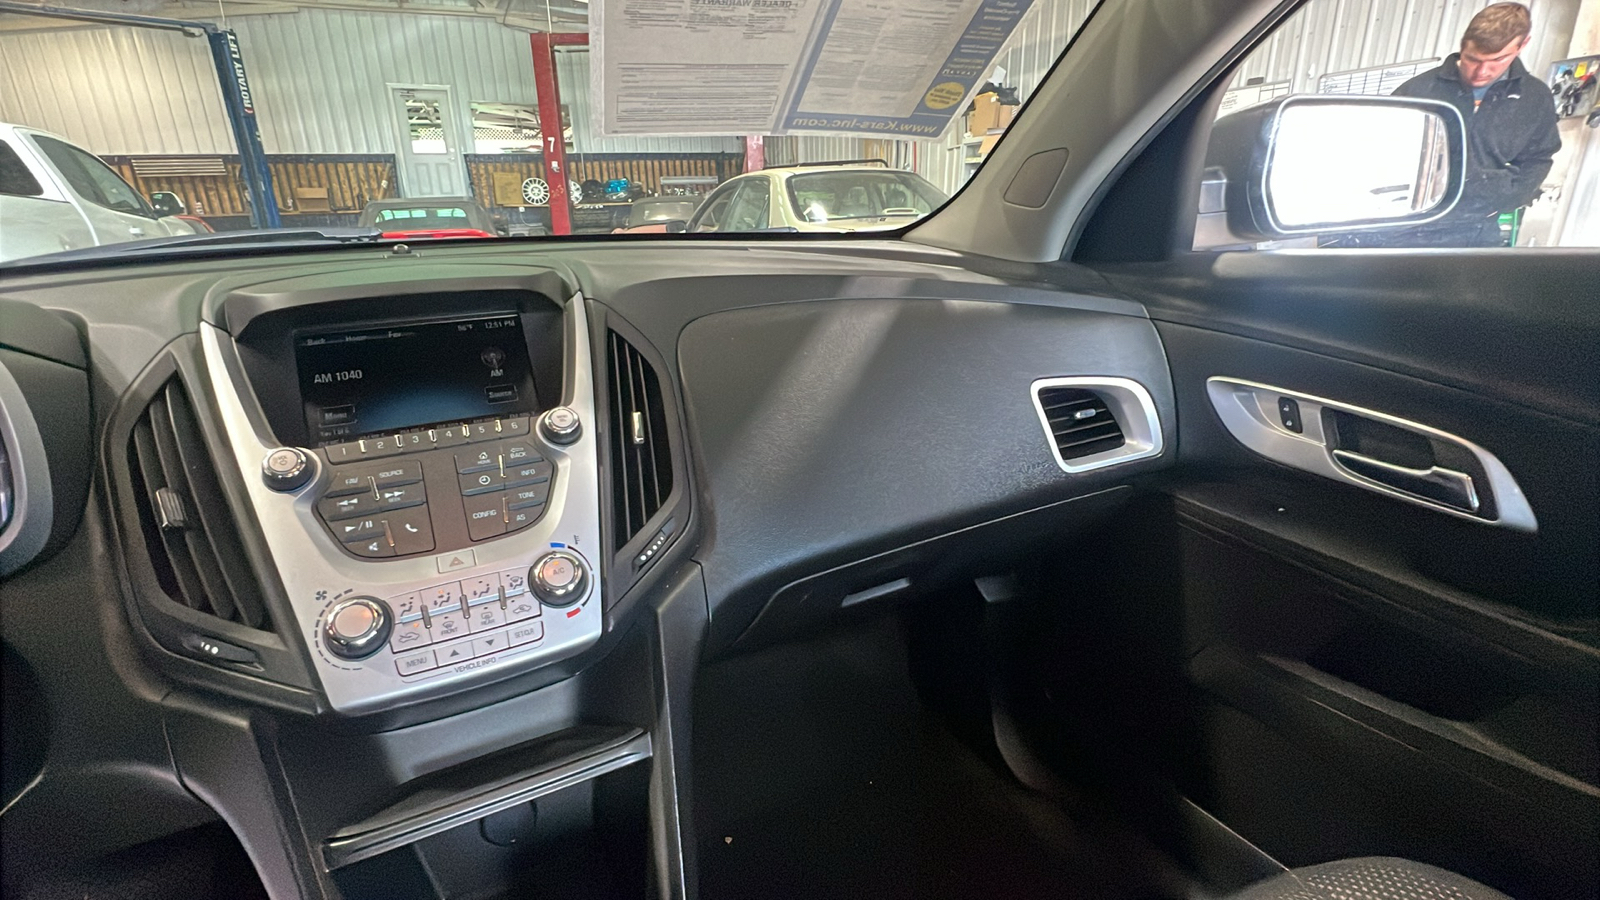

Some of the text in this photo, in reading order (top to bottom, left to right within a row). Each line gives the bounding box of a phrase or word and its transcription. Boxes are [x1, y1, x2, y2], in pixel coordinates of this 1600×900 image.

[227, 33, 252, 108] ROTARY LIFT
[547, 136, 555, 153] 7
[314, 369, 363, 383] AM 1040
[490, 369, 504, 377] AM
[510, 421, 519, 429] 6
[445, 430, 453, 438] 4
[412, 435, 420, 443] 3
[376, 441, 384, 449] 2
[341, 447, 347, 455] 1
[510, 451, 527, 459] BACK
[379, 469, 404, 478] SOURCE
[520, 468, 536, 476] INFO
[518, 491, 535, 499] TONE
[472, 509, 497, 519] CONFIG
[553, 567, 565, 576] A/C
[481, 618, 496, 626] REAR
[440, 627, 459, 636] FRONT
[406, 656, 427, 668] MENU
[454, 657, 497, 673] VEHICLE INFO
